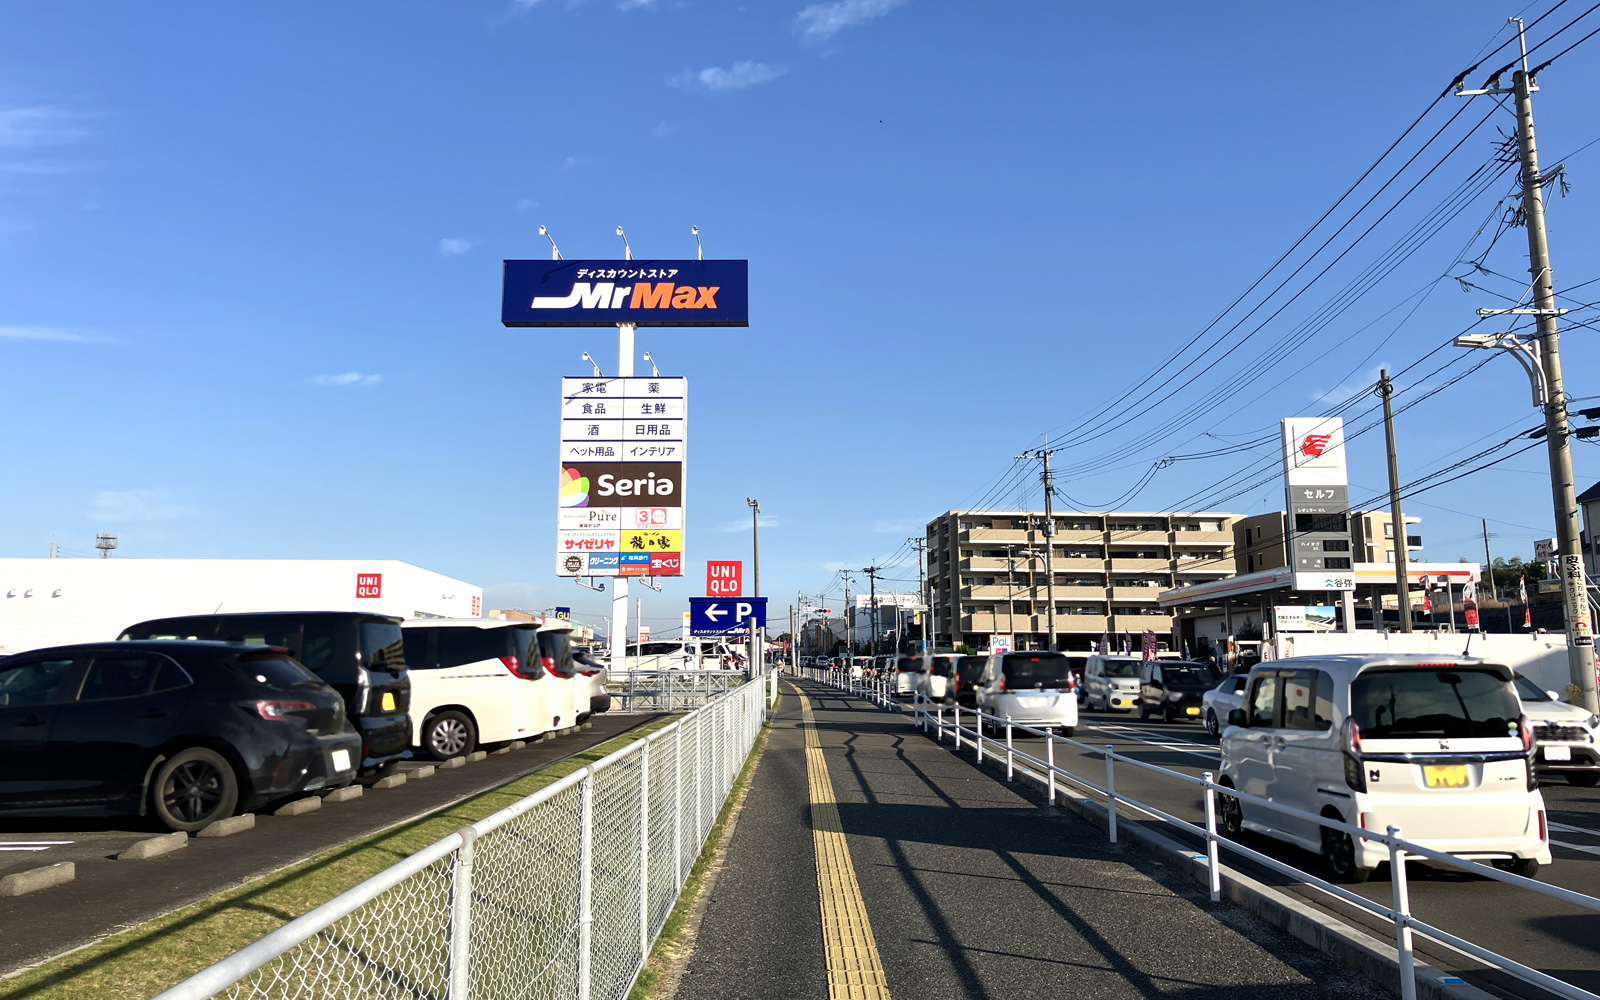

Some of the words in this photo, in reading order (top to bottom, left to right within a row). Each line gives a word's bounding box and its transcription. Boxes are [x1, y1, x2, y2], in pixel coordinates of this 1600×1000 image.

[577, 268, 678, 279] ディスカウントストア
[531, 282, 720, 309] MrMax
[582, 382, 607, 393] 家電
[648, 382, 660, 393] 薬
[582, 403, 606, 414] 食品
[641, 403, 666, 414] 生鮮
[587, 424, 599, 436] 酒
[636, 424, 670, 436] 日用品
[570, 446, 614, 457] ペット用品
[630, 446, 675, 457] インテリア
[597, 472, 674, 496] Seria
[1304, 489, 1335, 499] セルフ
[589, 510, 617, 521] Pure
[564, 538, 614, 549] サイゼリヤ
[590, 556, 619, 565] クリーニング
[651, 559, 679, 568] 宝くじ
[711, 565, 735, 578] UNI
[359, 576, 378, 585] UNI
[358, 586, 379, 596] QLO
[710, 580, 738, 593] QLO
[557, 611, 570, 620] GU
[736, 602, 752, 622] P
